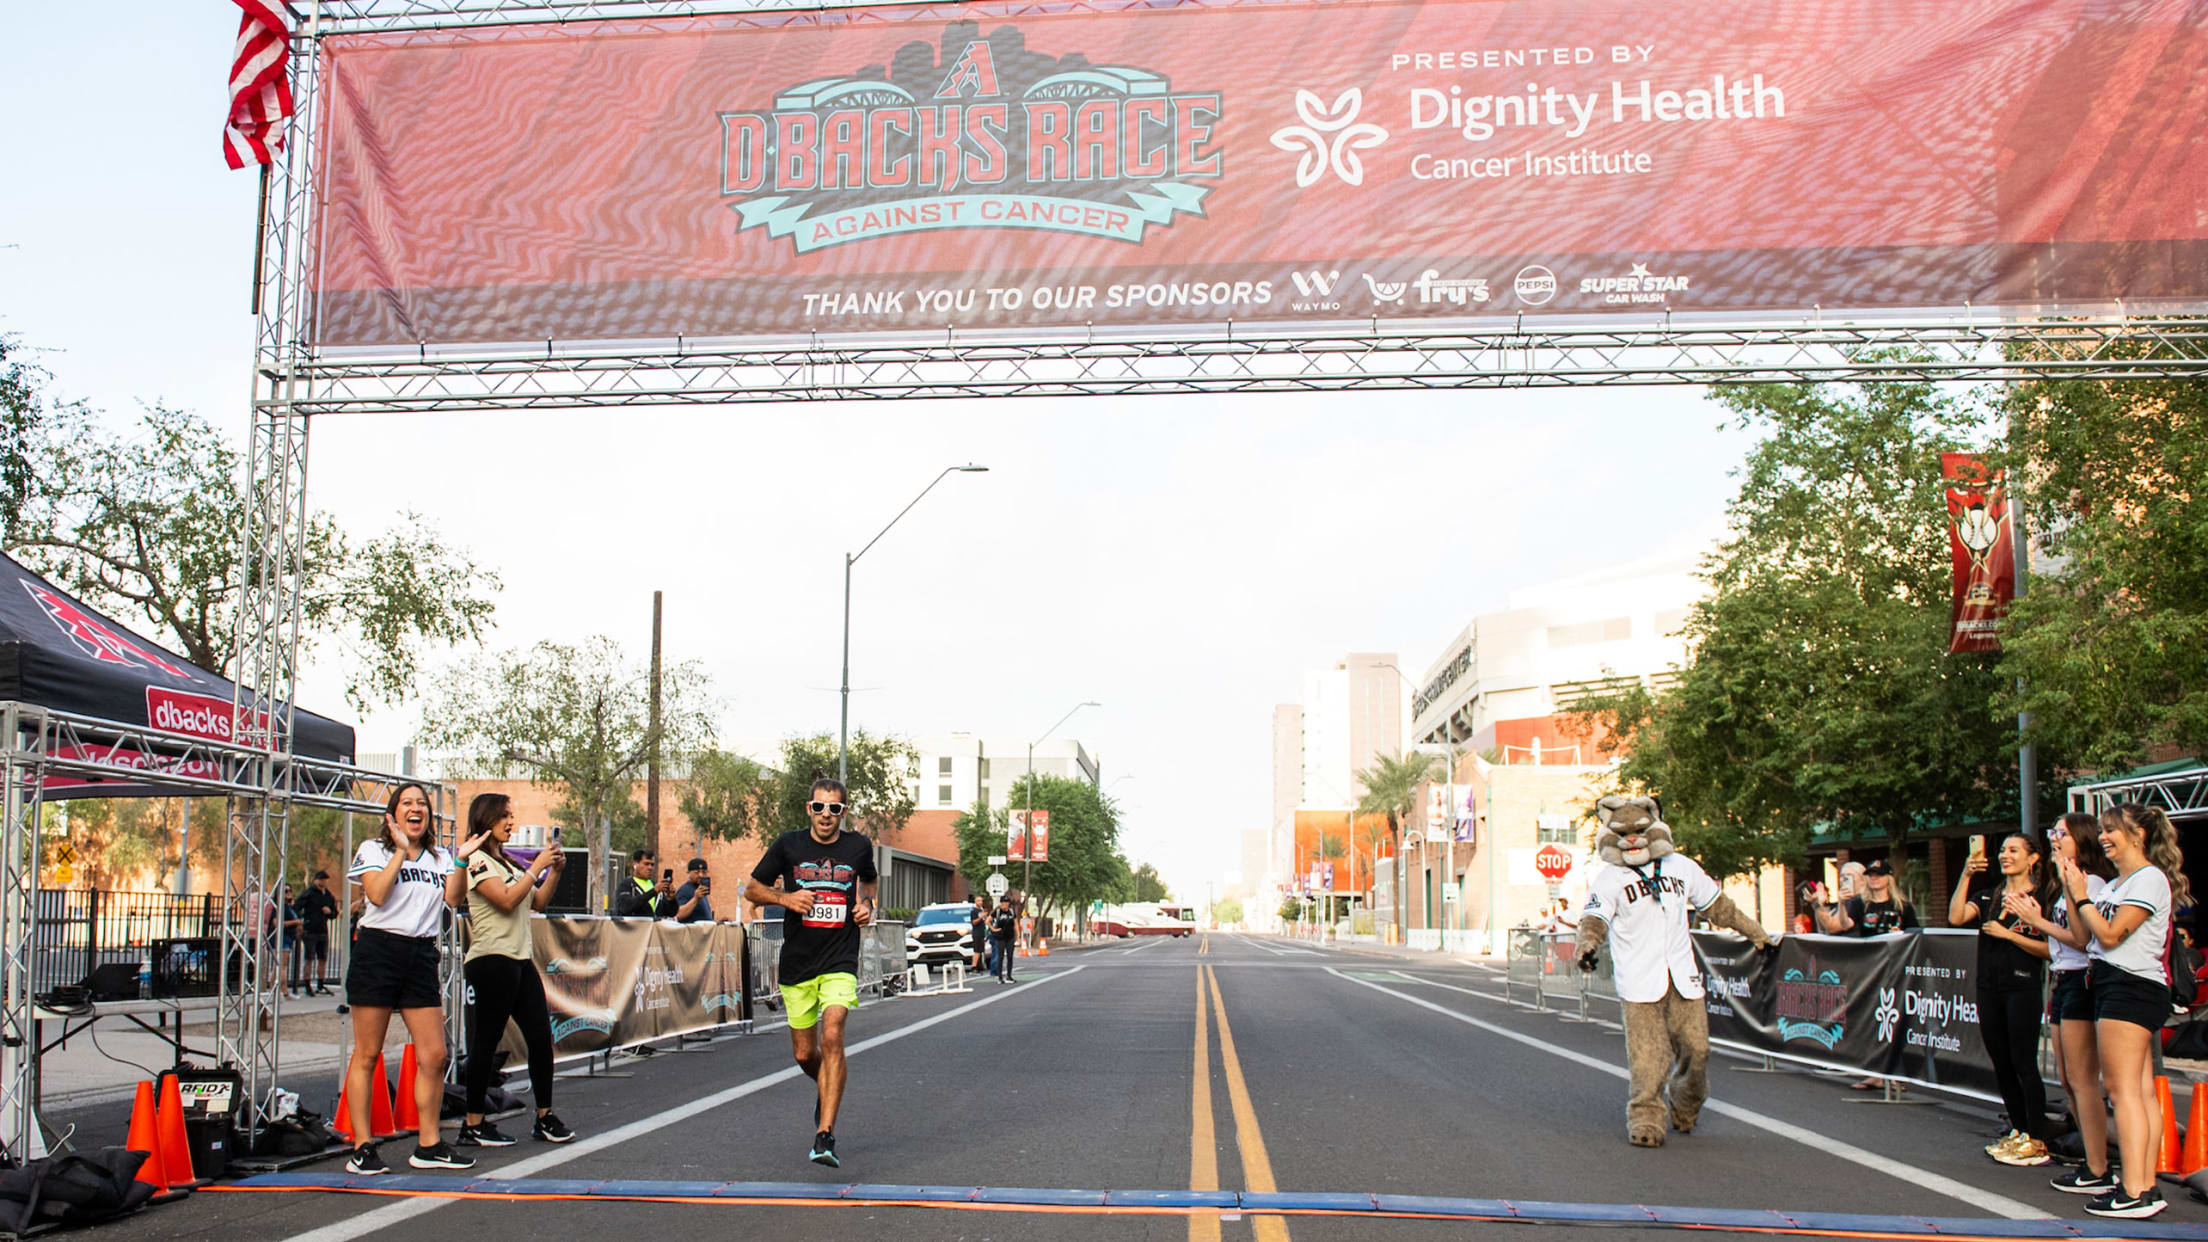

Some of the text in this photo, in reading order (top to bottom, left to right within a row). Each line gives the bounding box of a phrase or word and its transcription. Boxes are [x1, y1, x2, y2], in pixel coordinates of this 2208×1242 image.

[1392, 44, 1657, 71] PRESENTED BY
[1410, 73, 1786, 140] Dignity Health
[1025, 94, 1222, 183] RACE
[1410, 147, 1653, 180] Cancer Institute
[810, 199, 1131, 244] AGAINST CANCER
[1518, 280, 1553, 290] PEPSI
[1579, 275, 1690, 294] SUPER STAR
[802, 280, 1273, 317] THANK YOU TO OUR SPONSORS
[1292, 302, 1341, 312] WAYMO
[1606, 292, 1665, 304] CAR WASH
[1537, 853, 1571, 870] STOP
[1904, 965, 1967, 979] PRESENTED BY
[1904, 989, 1951, 1028] Dignity
[1927, 1031, 1961, 1053] Institute
[181, 1084, 217, 1094] RFID
